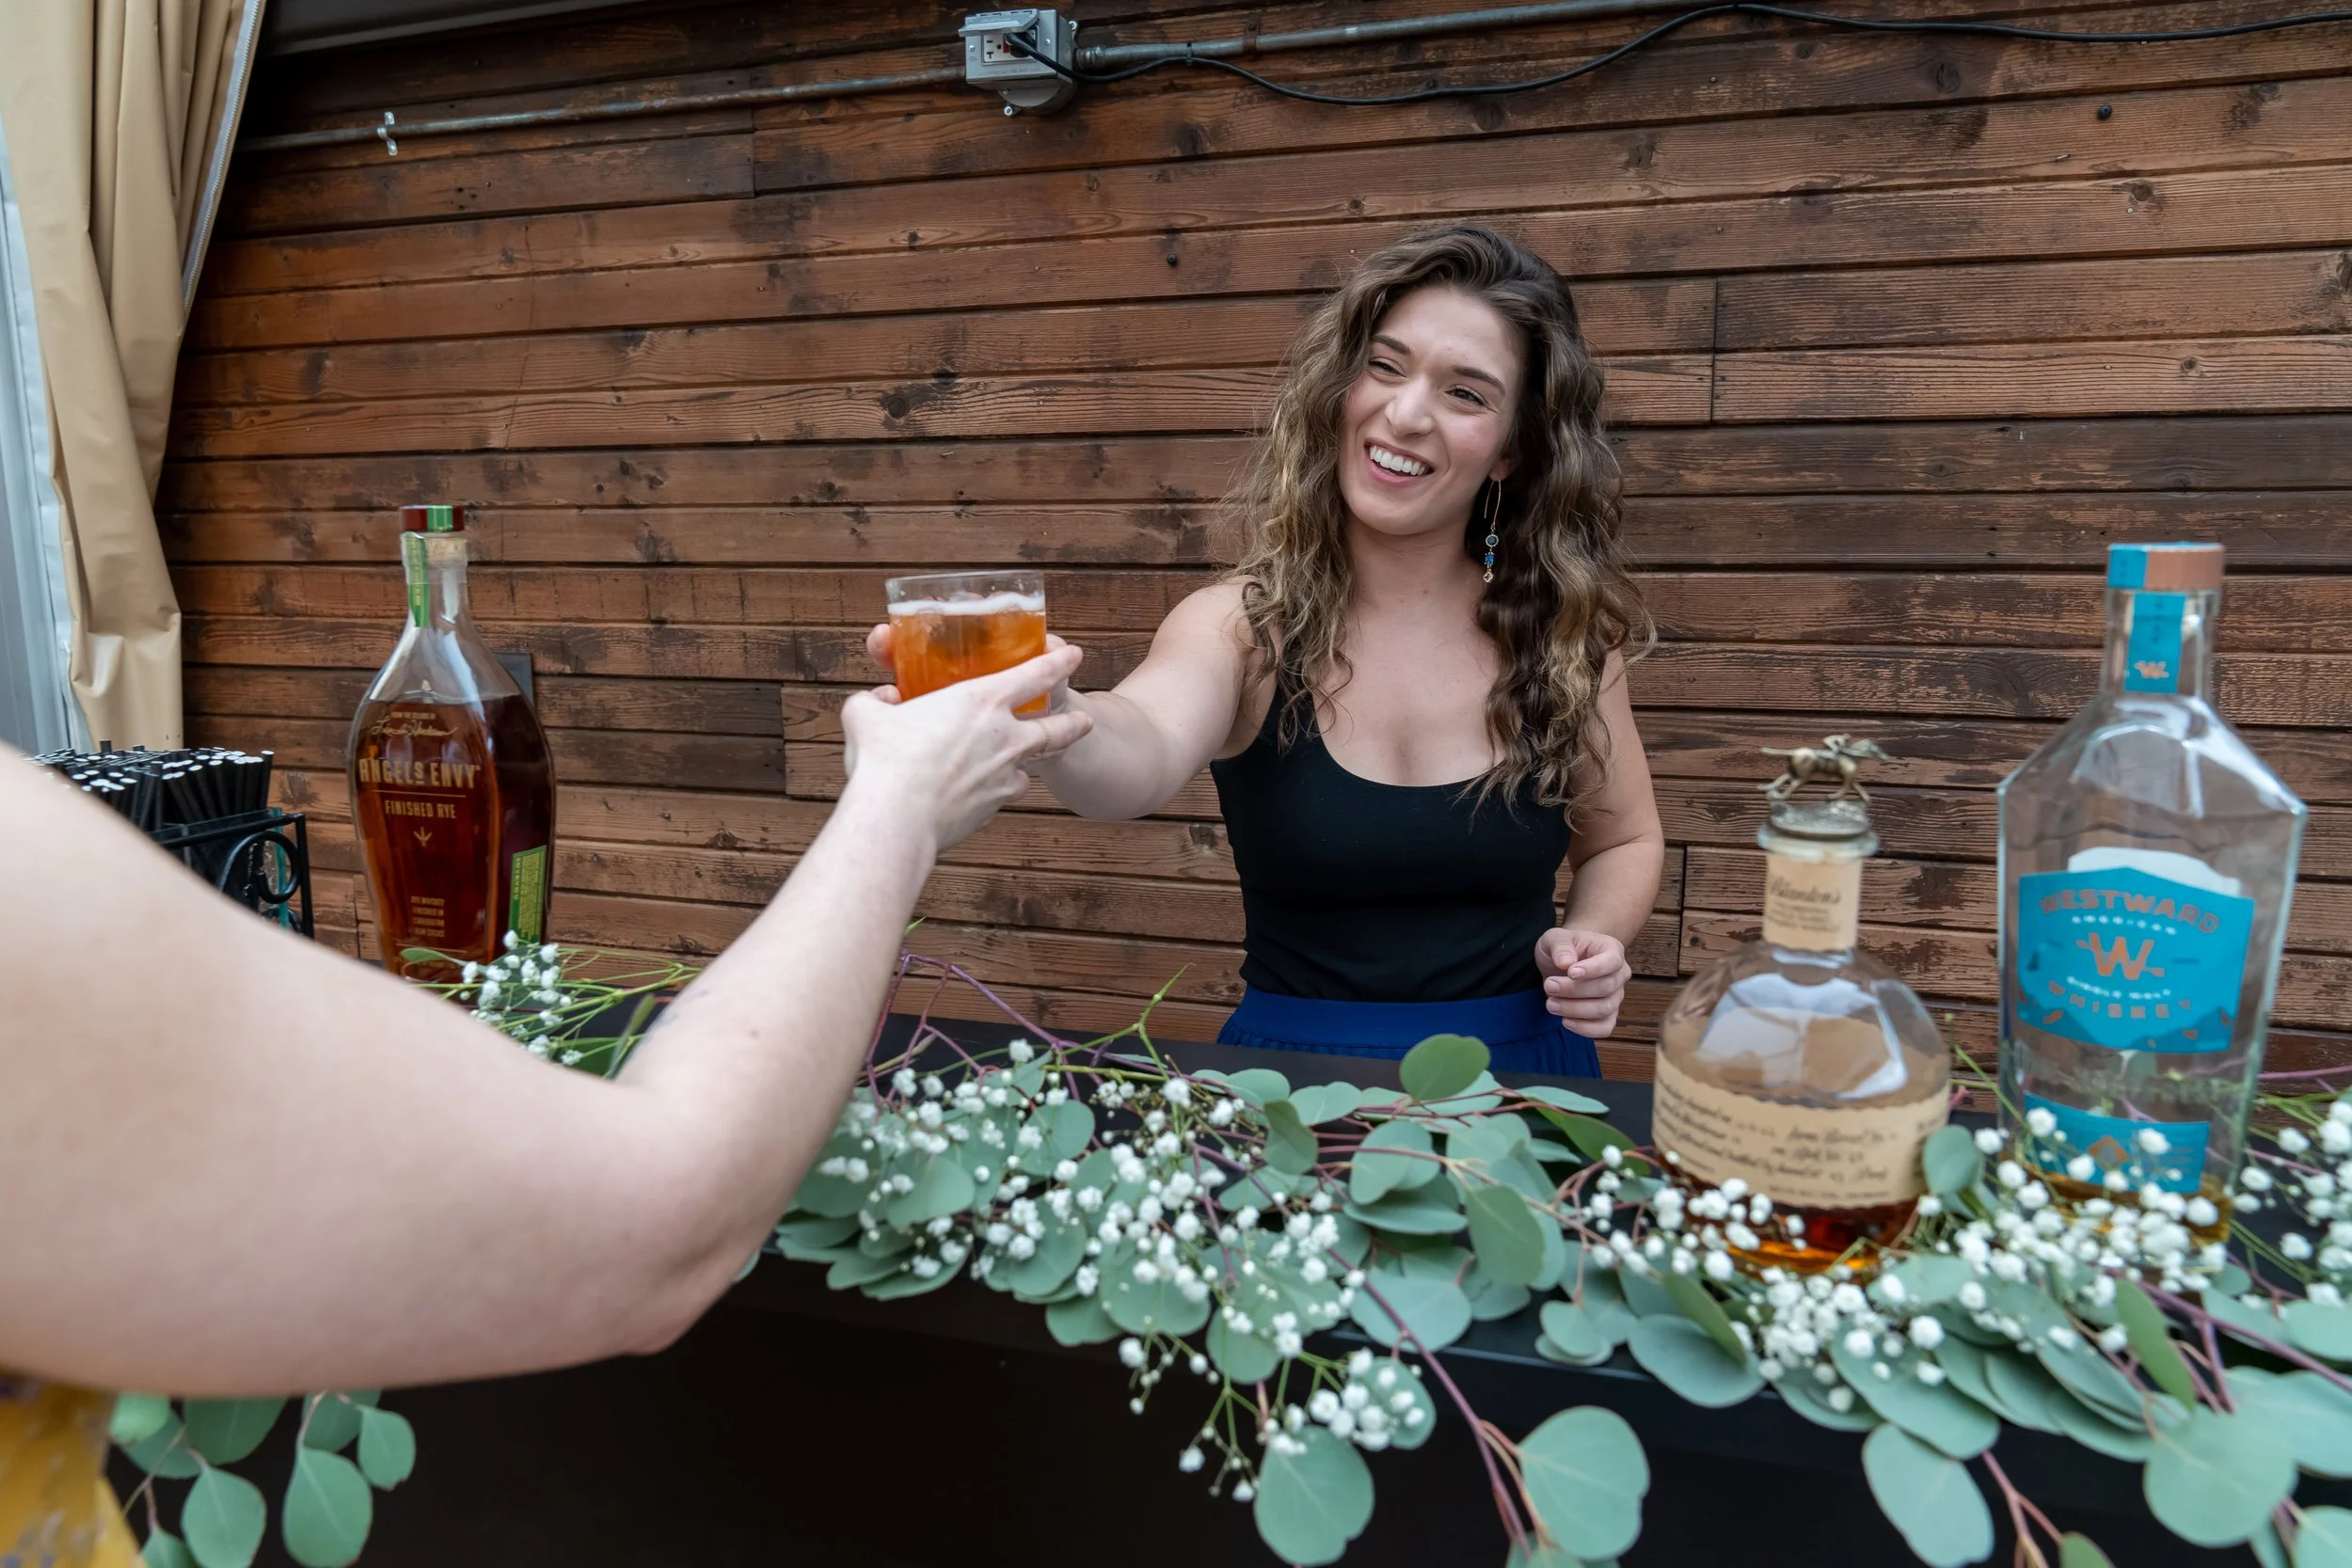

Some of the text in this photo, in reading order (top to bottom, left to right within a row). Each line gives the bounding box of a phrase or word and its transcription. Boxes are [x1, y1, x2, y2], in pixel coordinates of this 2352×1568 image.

[430, 762, 477, 788] ENVY
[384, 800, 457, 818] FINISHED RYE
[2040, 889, 2220, 934] WESTWARD
[2075, 932, 2165, 981] W
